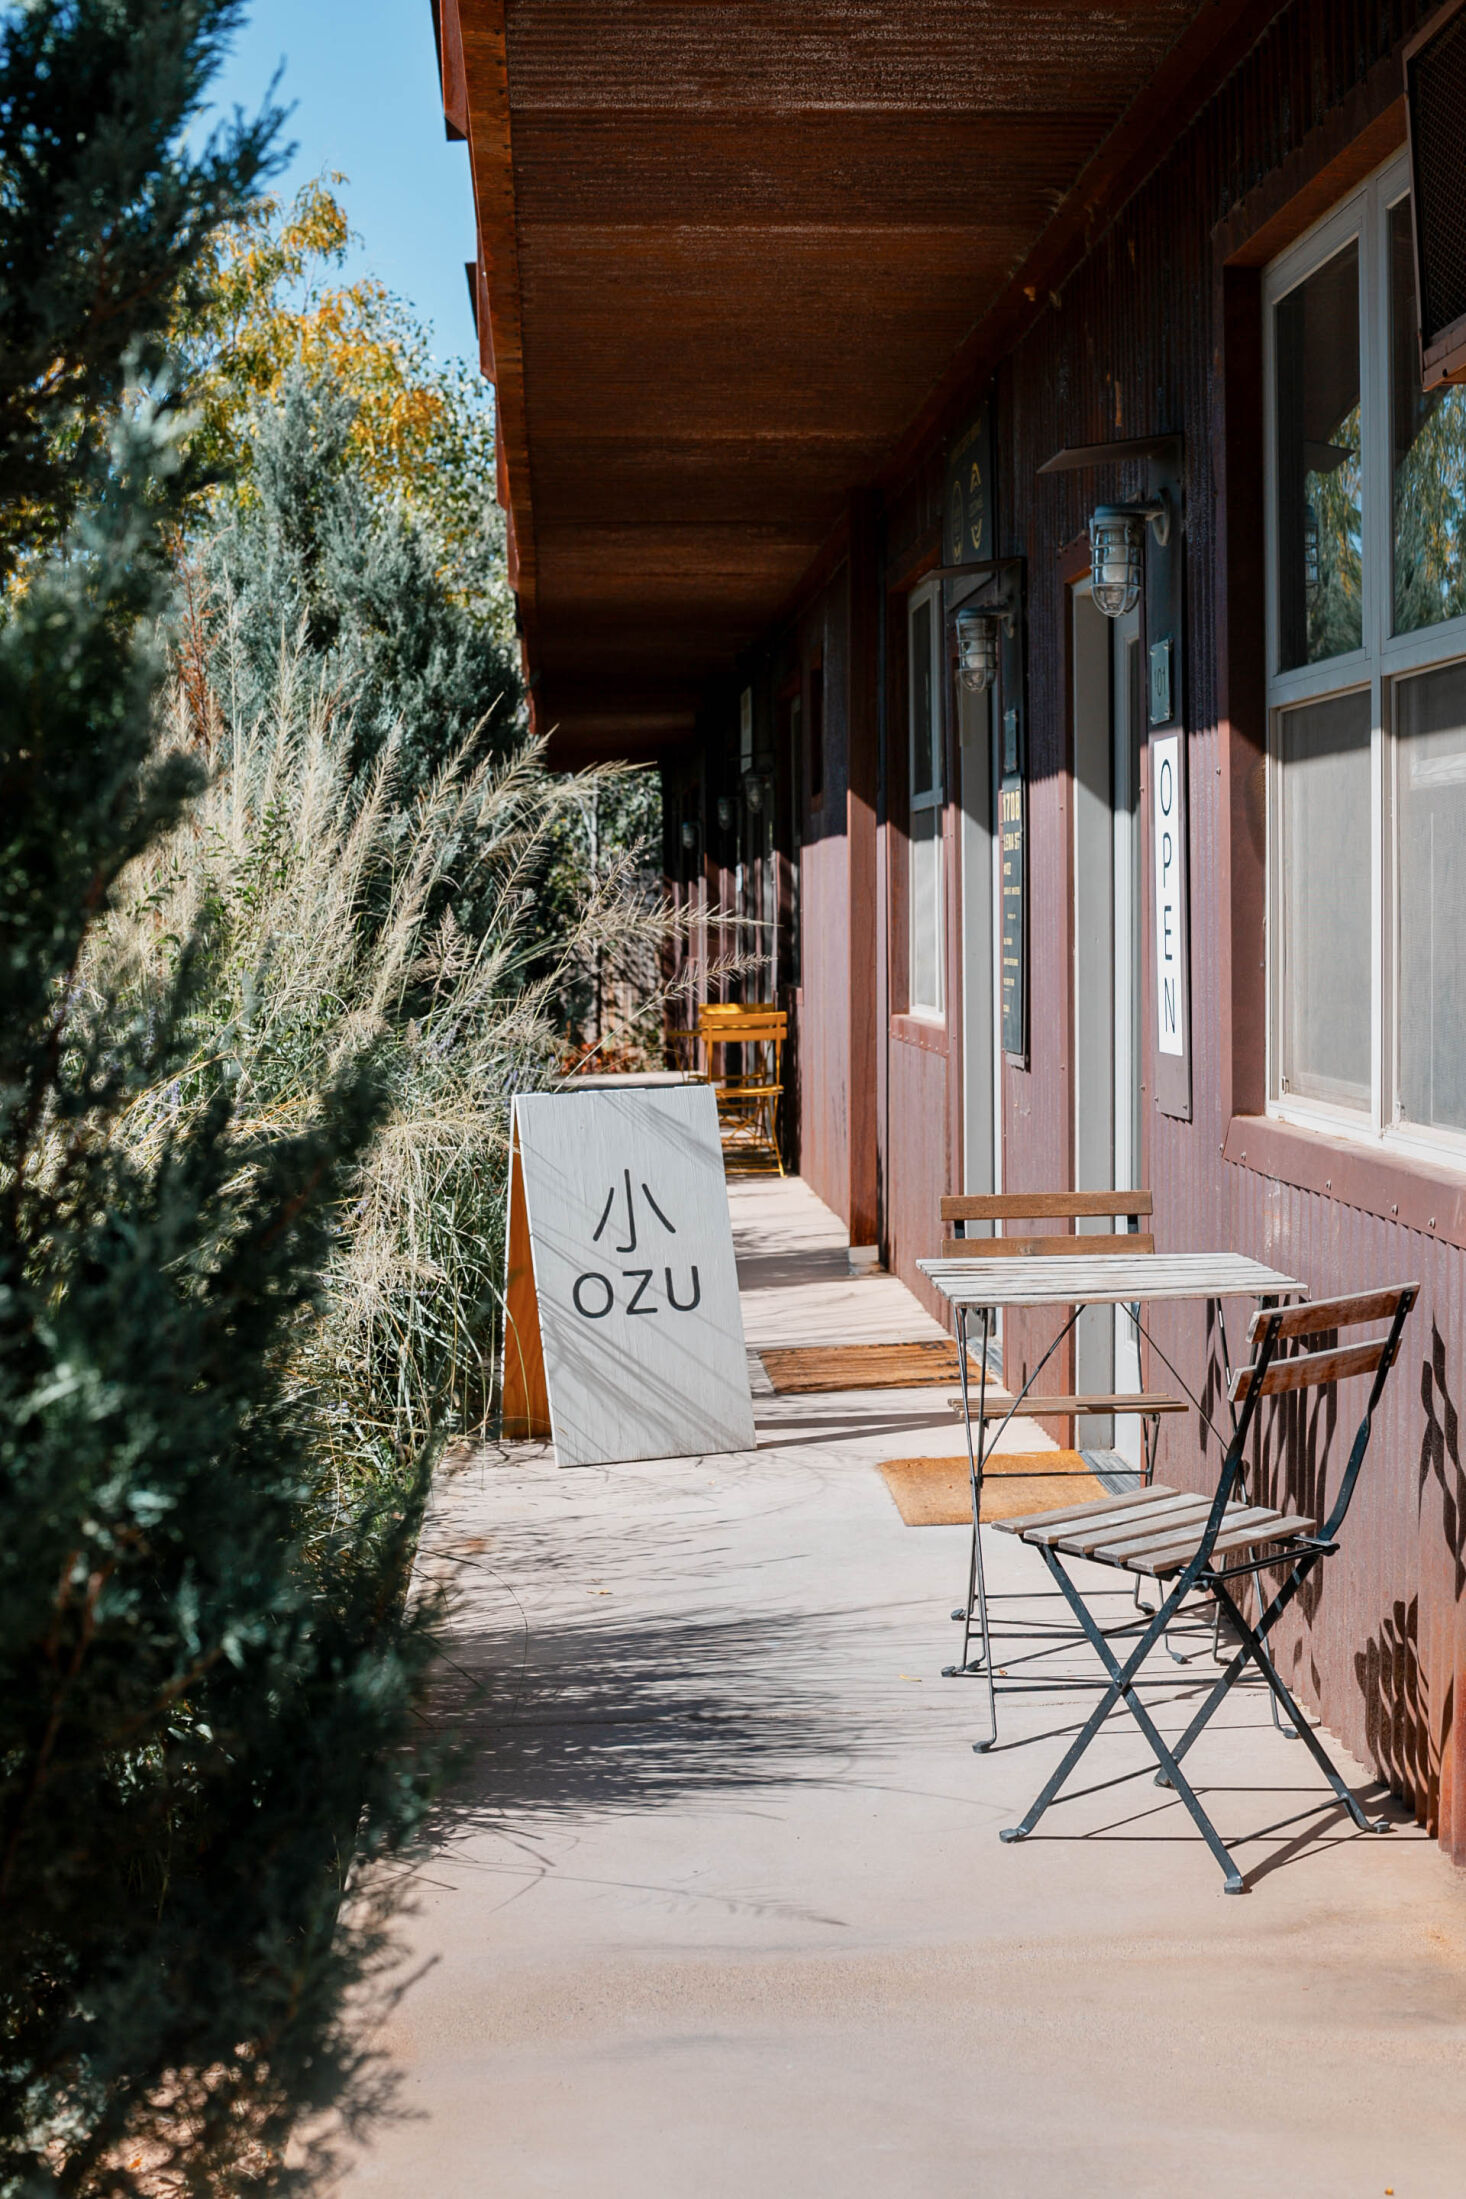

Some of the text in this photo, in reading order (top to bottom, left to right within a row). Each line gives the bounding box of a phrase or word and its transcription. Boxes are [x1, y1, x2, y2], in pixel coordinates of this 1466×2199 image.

[1159, 758, 1176, 1034] OPEN
[593, 1168, 676, 1253] 小
[572, 1265, 701, 1319] OZU
